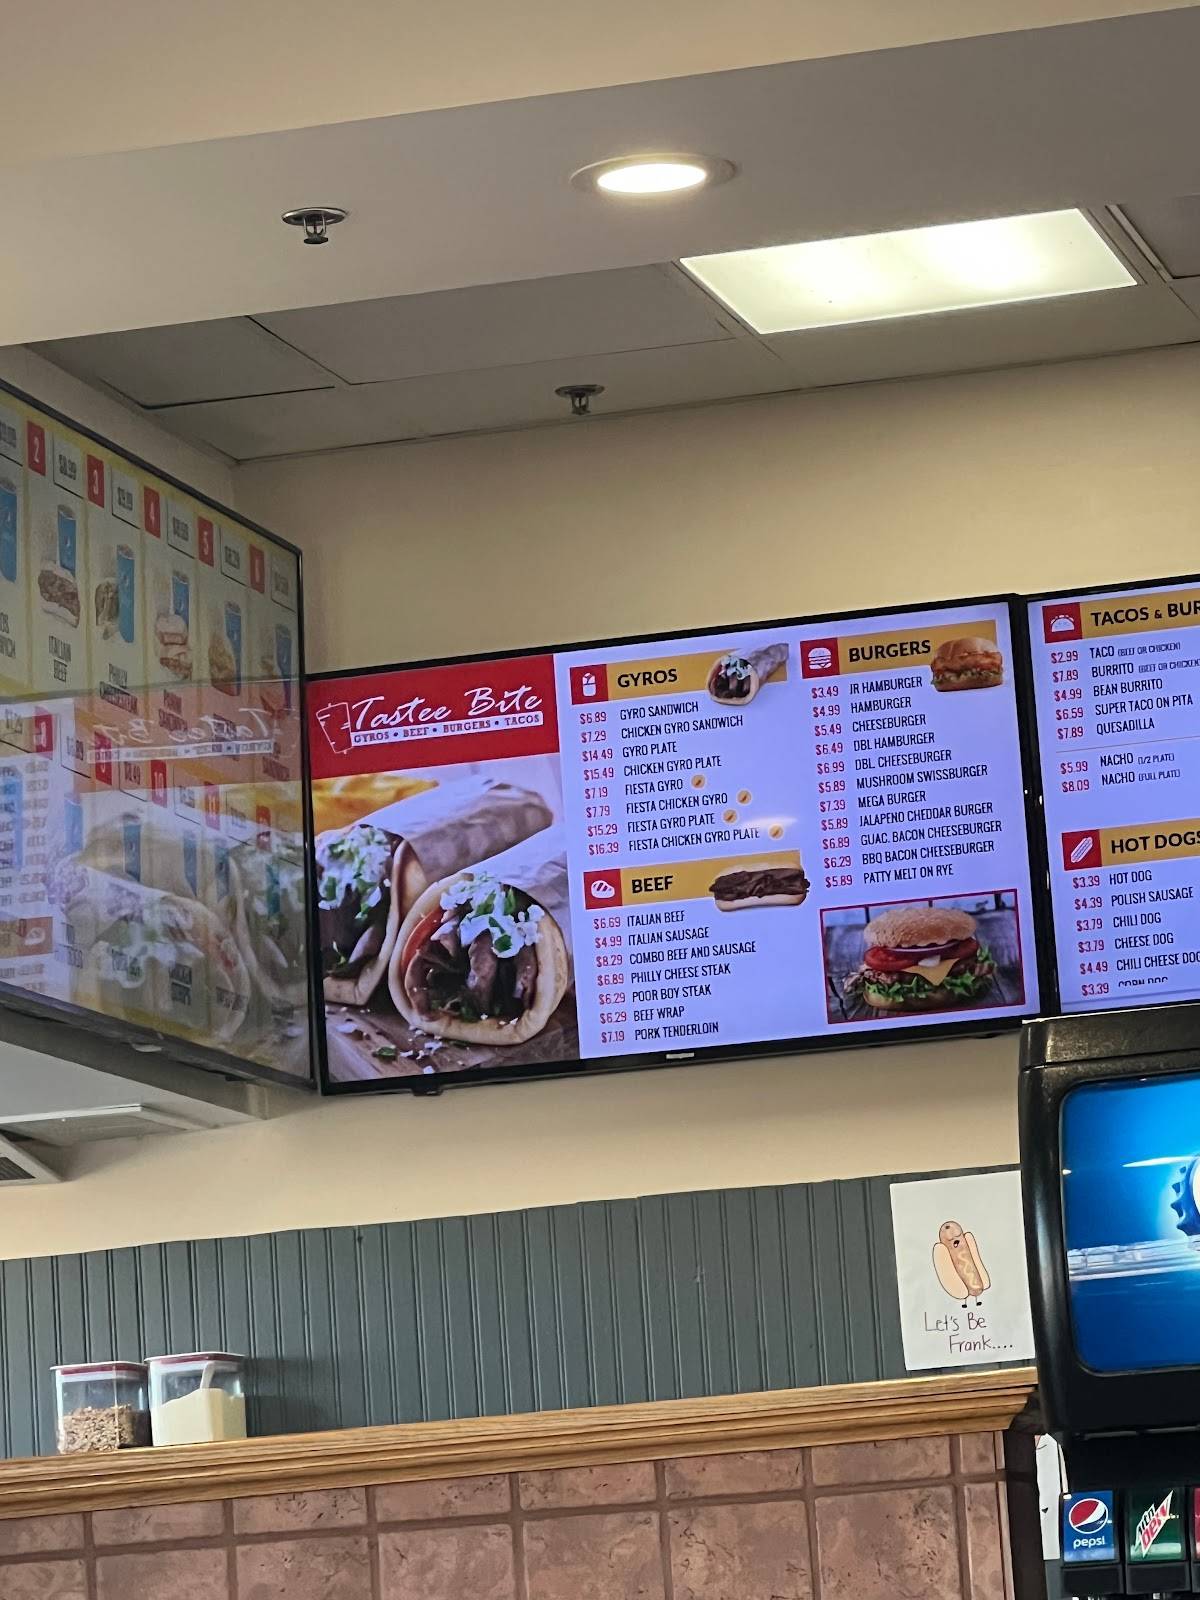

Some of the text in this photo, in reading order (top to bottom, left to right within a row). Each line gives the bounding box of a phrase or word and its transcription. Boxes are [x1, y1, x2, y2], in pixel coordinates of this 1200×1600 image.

[34, 436, 40, 463] 2
[1091, 607, 1149, 626] TACOS
[1155, 610, 1162, 619] &
[849, 640, 931, 662] BURGERS
[1051, 651, 1079, 664] $2.99
[1090, 646, 1114, 659] TACO
[617, 669, 678, 688] GYROS
[1053, 670, 1079, 683] $7.89
[1092, 663, 1134, 678] BURRITO
[811, 676, 923, 699] $3.49 JR HAMBURGER
[1054, 678, 1163, 701] $4.99 BEAN BURRITO
[352, 685, 543, 730] Tastee Bite
[580, 701, 699, 724] $6.89 GYRO SANDWICH
[813, 696, 911, 718] $4.99 HAMBURGER
[1056, 694, 1193, 720] $6.59 SUPER TACO ON PITA
[354, 714, 540, 743] GYROS BEEF BURGERS TACOS
[581, 715, 743, 743] $7.29 CHICKEN GYRO SANDWICH
[814, 714, 926, 736] $5.49 CHEESEBURGER
[1057, 718, 1155, 740] $7.89 QUESADILLA
[622, 744, 648, 758] GYRO
[651, 741, 677, 755] PLATE
[816, 732, 935, 755] $6.49 DBL HAMBURGER
[624, 762, 664, 777] CHICKEN
[667, 758, 693, 772] GYRO
[695, 755, 722, 769] PLATE
[817, 762, 844, 774] $6.99
[878, 749, 952, 768] CHEESEBURGER
[1061, 761, 1088, 774] $5.99
[1100, 753, 1134, 767] NACHO
[625, 781, 655, 796] FIESTA
[658, 779, 683, 793] GYRO
[818, 764, 988, 793] $5.89 MUSHROOM SWISSBURGER
[1062, 779, 1089, 793] $8.09
[1102, 771, 1135, 785] NACHO
[626, 800, 656, 814] FIESTA
[659, 795, 699, 811] CHICKEN
[702, 793, 728, 807] GYRO
[820, 791, 926, 812] $7.39 MEGA BURGER
[587, 813, 715, 837] $15.29 FIESTA GYRO PLATE
[821, 818, 848, 831] $5.89
[907, 806, 951, 822] CHEDDAR
[954, 802, 993, 817] BURGER
[588, 827, 760, 856] $16.39 FIESTA CHICKEN GYRO PLATE
[822, 820, 1002, 849] $6.89 GUAC. BACON CHEESEBURGER
[1111, 836, 1150, 854] HOT
[824, 840, 995, 868] $6.29 BBQ BACON CHEESEBURGER
[632, 876, 673, 893] BEEF
[825, 864, 953, 888] $5.89 PATTY MELT ON RYE
[1072, 870, 1152, 889] $3.39 HOT DOG
[1075, 887, 1193, 910] $4.39 POLISH SAUSAGE
[593, 911, 685, 929] $6.69 ITALIAN BEEF
[1077, 912, 1161, 932] $3.79 CHILI DOG
[595, 927, 710, 948] $4.99 ITALIAN SAUSAGE
[1078, 933, 1174, 953] $3.79 CHEESE DOG
[596, 941, 756, 967] $8.29 COMBO BEEF AND SAUSAGE
[1116, 958, 1142, 971] CHILI
[1144, 953, 1180, 968] CHEESE
[597, 963, 731, 986] $6.89 PHILLY CHEESE STEAK
[599, 984, 712, 1005] $6.29 POOR BOY STEAK
[1082, 983, 1109, 996] $3.39
[600, 1006, 684, 1024] $6.29 BEEF WRAP
[635, 1026, 661, 1041] PORK
[663, 1022, 719, 1038] TENDERLOIN
[925, 1311, 986, 1332] Let's Be
[1073, 1536, 1106, 1549] pepsi
